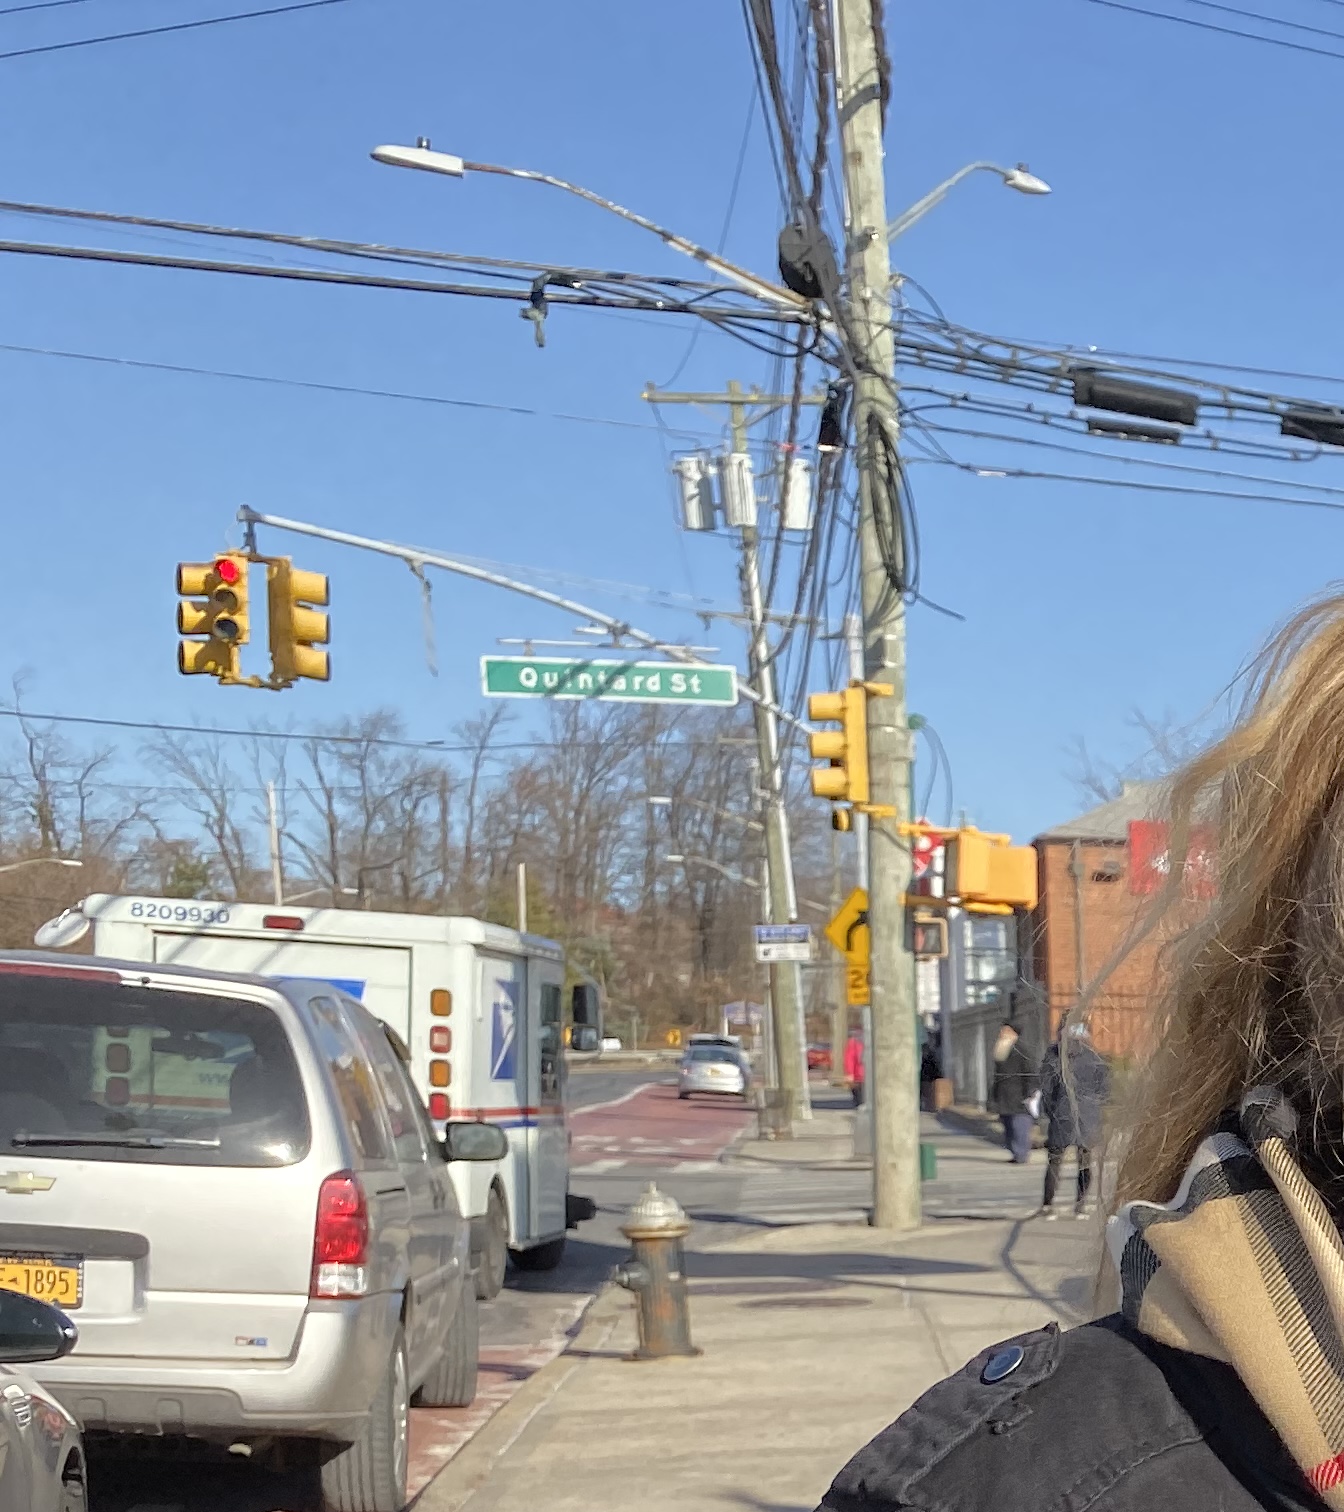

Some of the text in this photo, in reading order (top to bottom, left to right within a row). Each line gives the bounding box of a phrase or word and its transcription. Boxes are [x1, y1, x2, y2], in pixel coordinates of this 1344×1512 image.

[518, 666, 702, 694] Quintard St
[130, 902, 230, 924] 8209930
[24, 1268, 70, 1296] 1895
